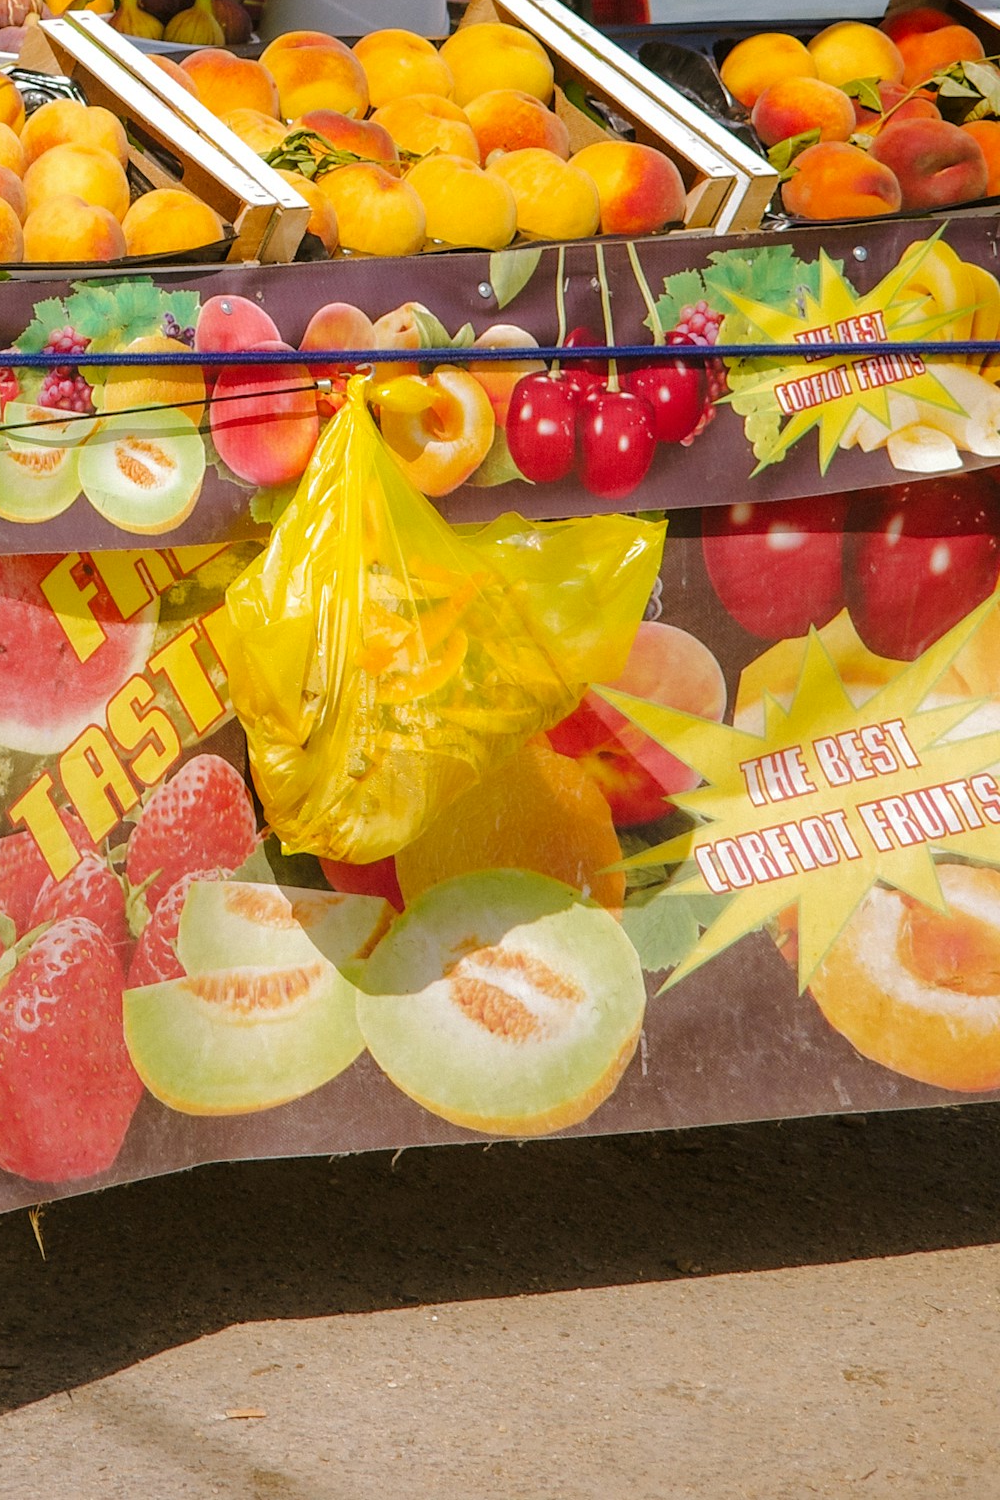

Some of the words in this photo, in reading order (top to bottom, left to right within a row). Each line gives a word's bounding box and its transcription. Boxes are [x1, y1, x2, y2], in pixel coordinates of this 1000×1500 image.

[774, 364, 853, 416] CORFIOT
[852, 352, 926, 391] FRUITS
[740, 745, 817, 807] THE
[812, 718, 922, 788] BEST
[694, 810, 863, 895] CORFIOT
[857, 772, 1000, 852] FRUITS
